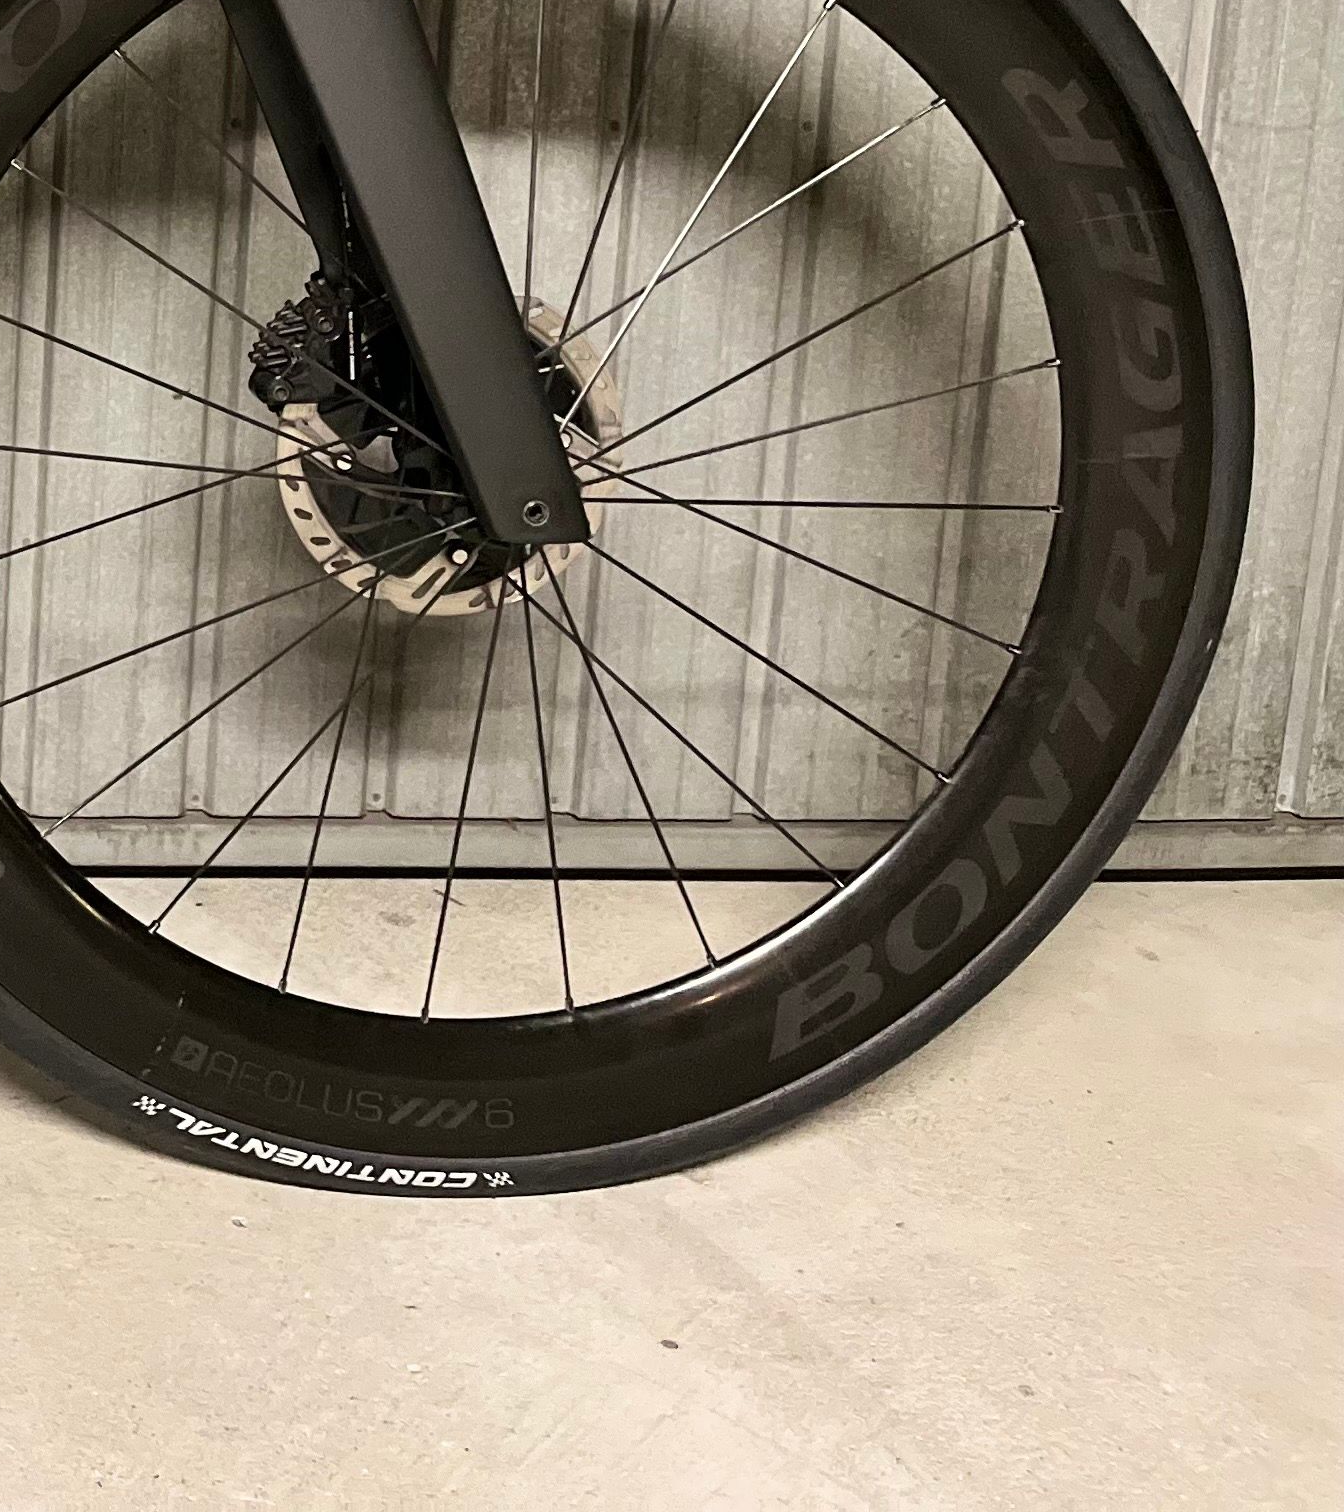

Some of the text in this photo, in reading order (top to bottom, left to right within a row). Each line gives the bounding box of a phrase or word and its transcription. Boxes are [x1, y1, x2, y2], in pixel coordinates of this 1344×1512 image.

[768, 67, 1184, 1063] BONTRAGER
[204, 1049, 385, 1123] AEOLUS
[169, 1107, 478, 1188] CONTINENTAL
